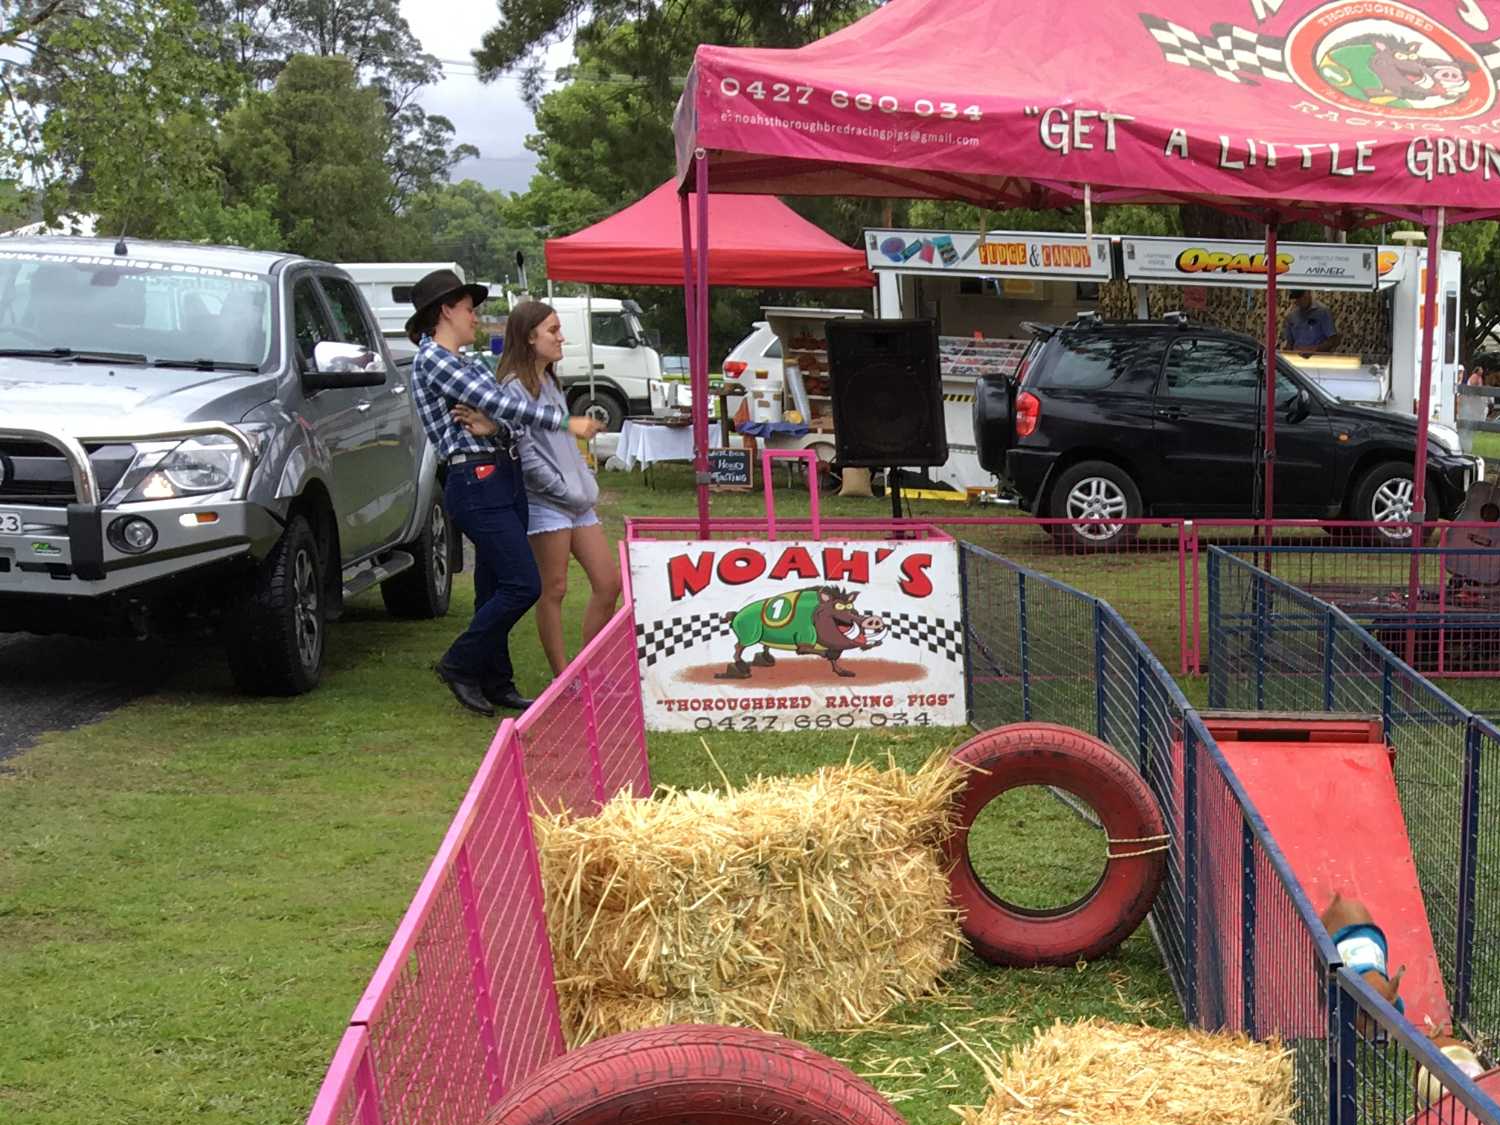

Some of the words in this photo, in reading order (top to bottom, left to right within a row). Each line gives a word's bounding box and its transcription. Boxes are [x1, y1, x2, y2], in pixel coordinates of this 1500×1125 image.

[720, 77, 814, 105] 0427
[914, 99, 983, 121] 034
[1024, 106, 1136, 156] "GET
[1164, 127, 1190, 158] A
[1218, 134, 1379, 177] LITTLE
[1030, 244, 1040, 267] &
[668, 546, 933, 601] NOAH'S
[825, 695, 894, 710] RACING
[694, 714, 777, 731] 0427
[793, 713, 855, 729] 660
[869, 711, 932, 727] 034
